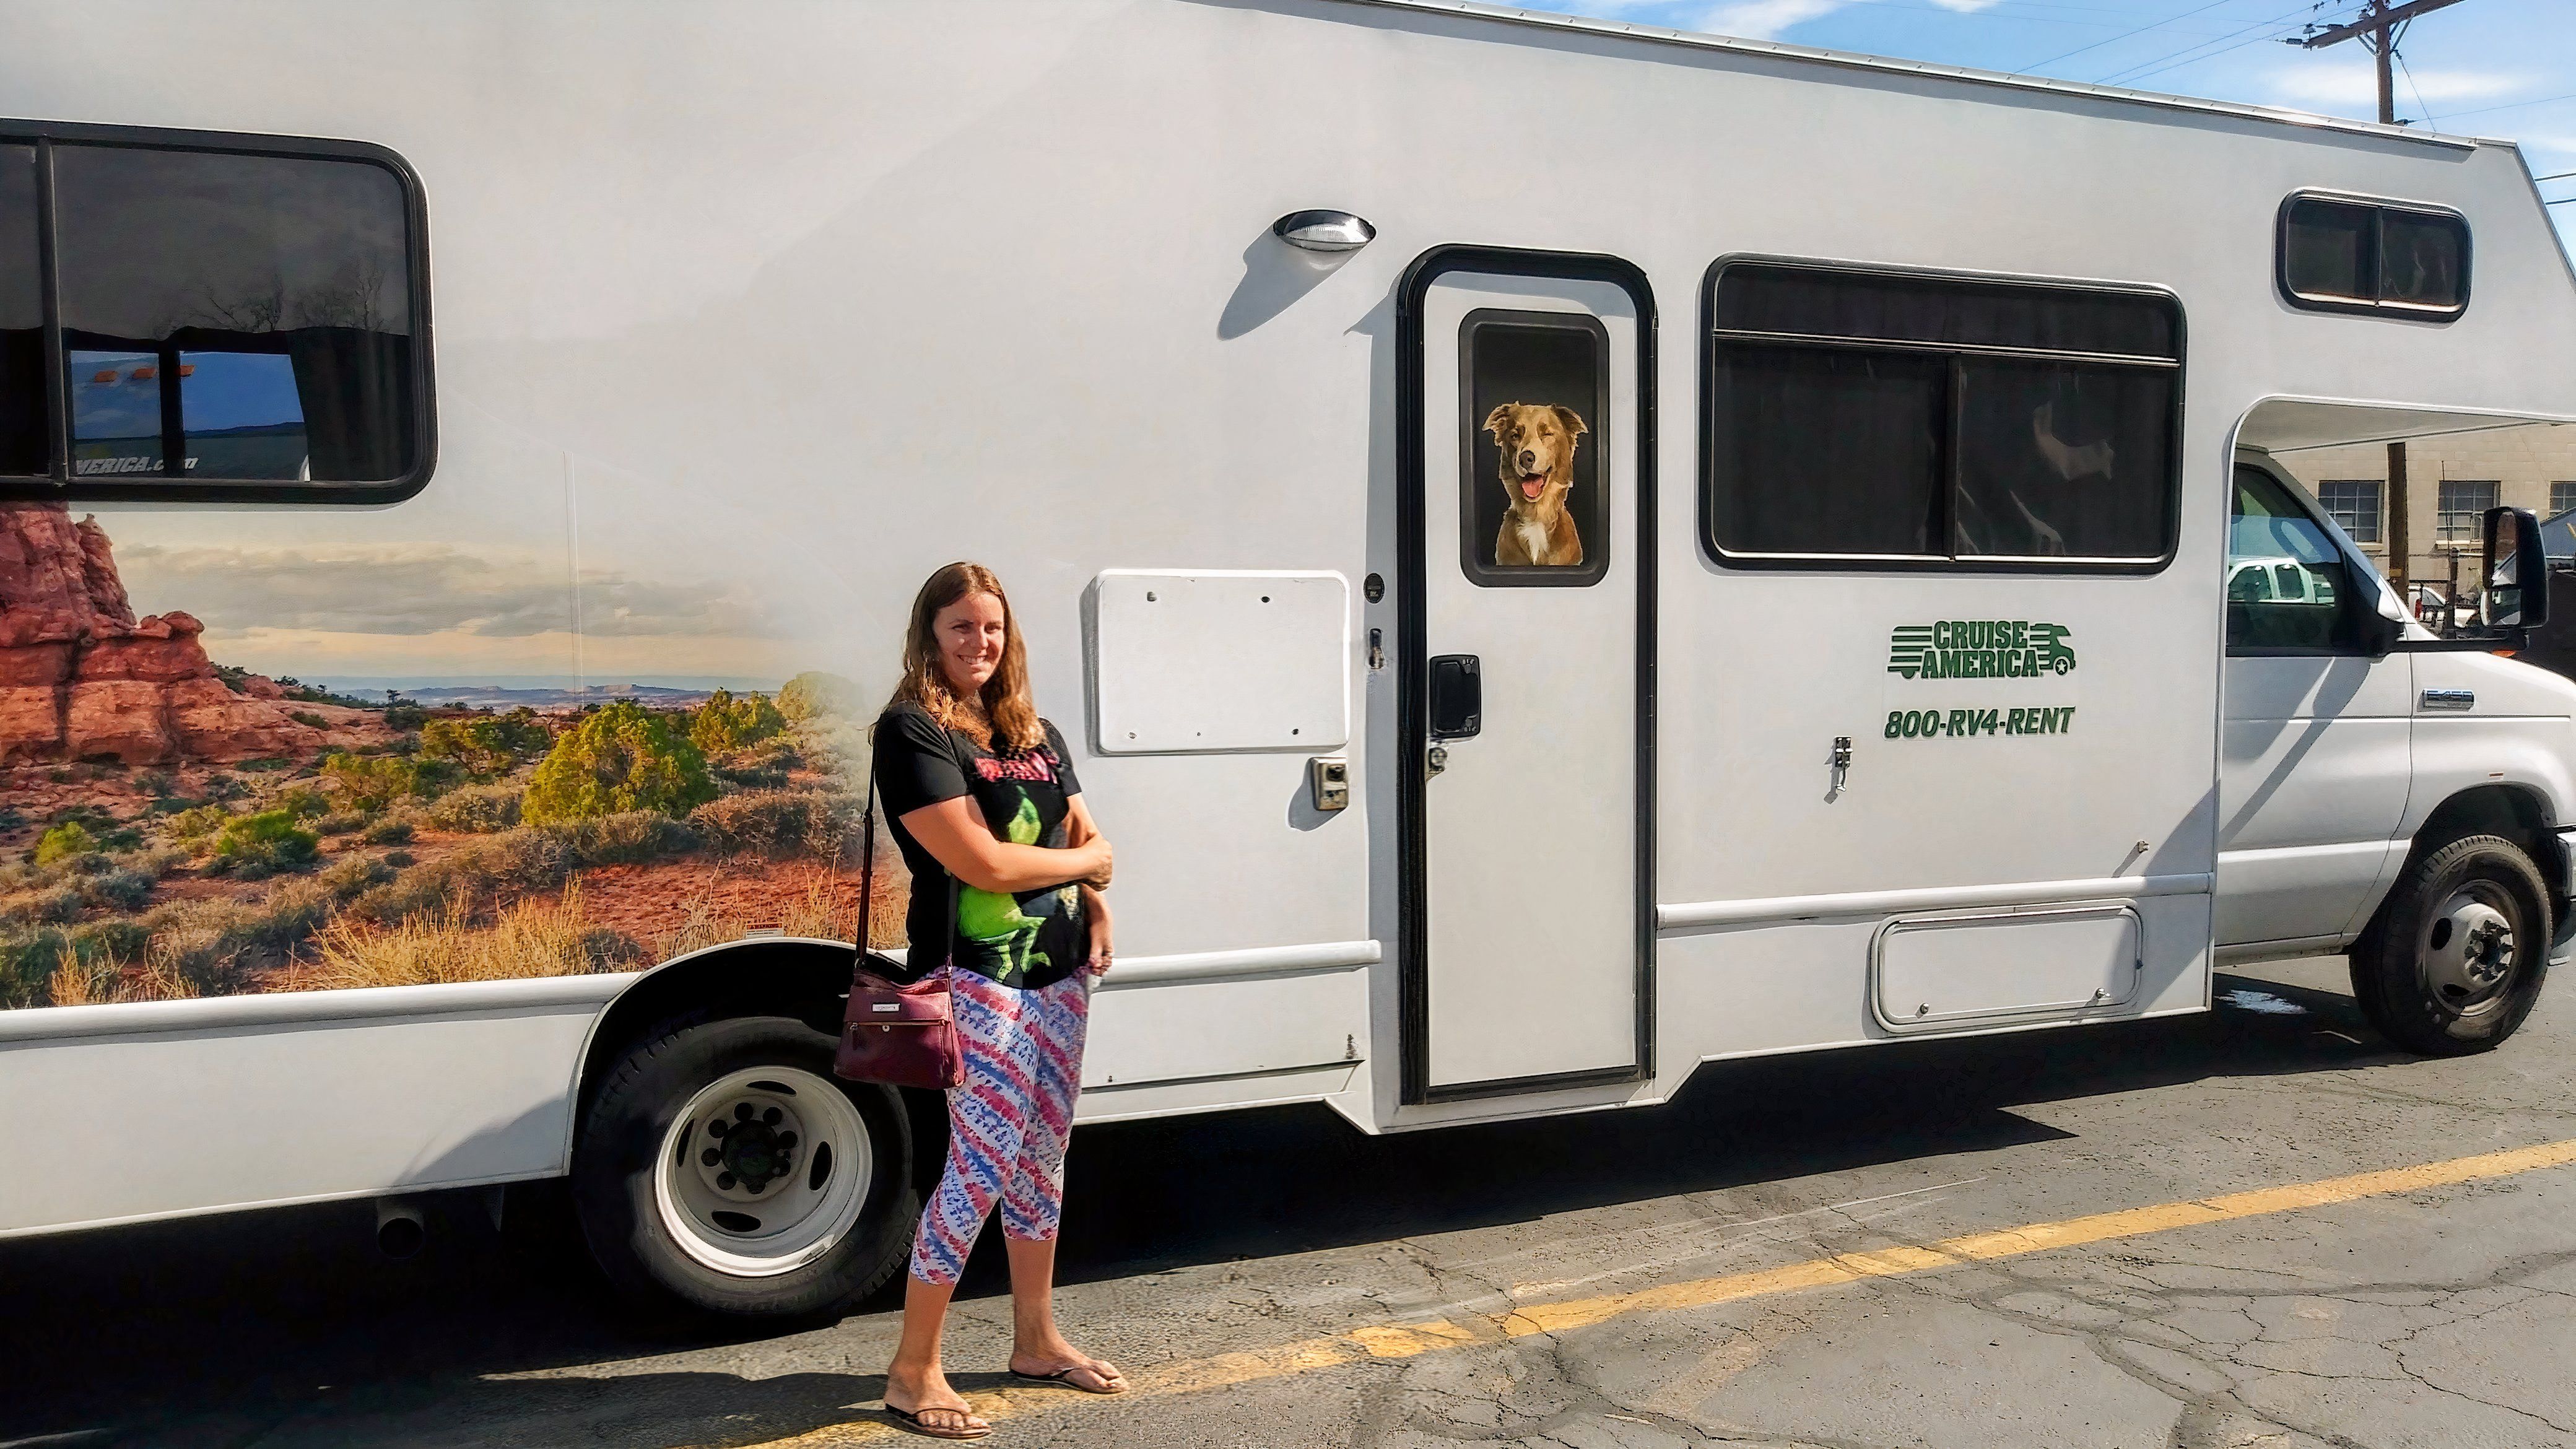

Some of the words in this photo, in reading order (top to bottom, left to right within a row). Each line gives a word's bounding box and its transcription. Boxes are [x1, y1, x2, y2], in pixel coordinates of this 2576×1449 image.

[1933, 620, 2028, 649] CRUISE
[1920, 650, 2039, 679] AMERICA
[1884, 706, 2076, 738] 800-RV4-RENT
